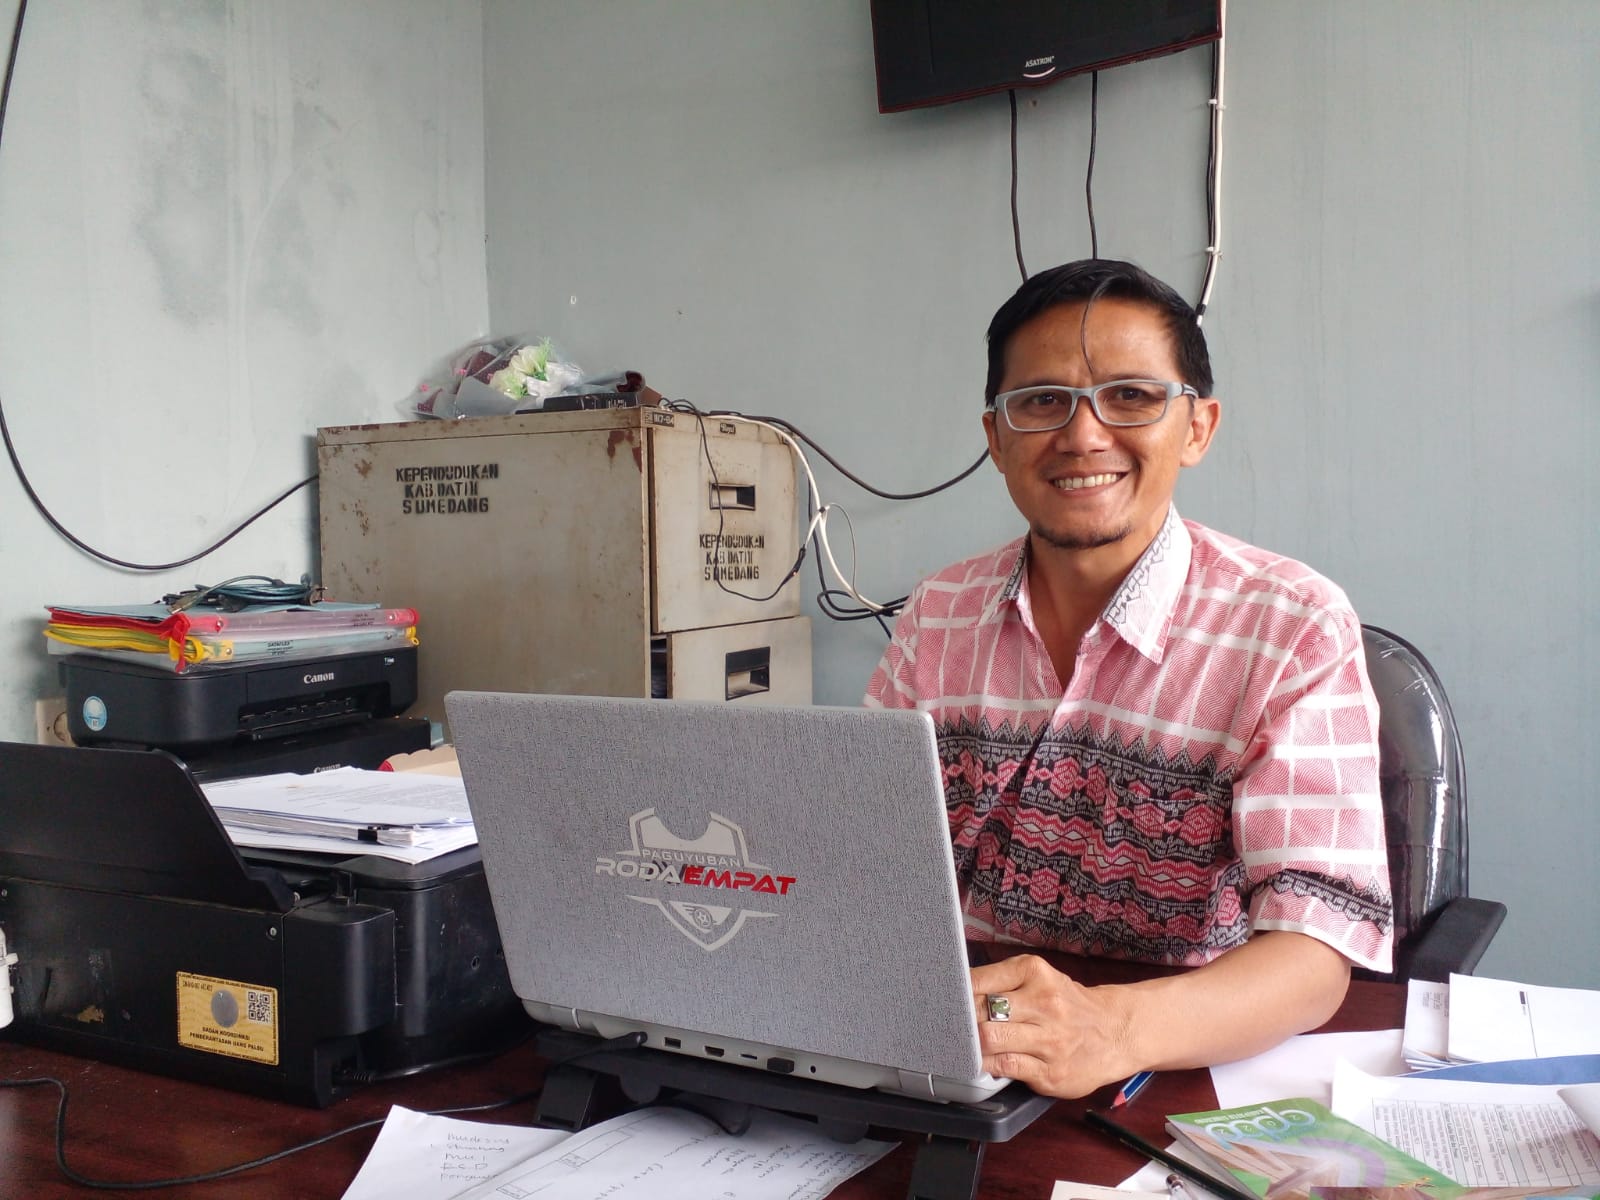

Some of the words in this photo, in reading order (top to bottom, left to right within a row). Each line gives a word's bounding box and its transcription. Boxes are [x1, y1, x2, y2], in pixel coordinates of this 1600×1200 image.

[396, 463, 499, 482] KEPENDUDUKAN
[403, 498, 489, 514] SUMEDANG
[704, 565, 760, 581] SUMEDANG
[303, 671, 335, 684] Canon
[642, 848, 741, 867] PAGUYUBAN
[595, 856, 681, 885] RODA
[682, 864, 797, 895] EMPAT
